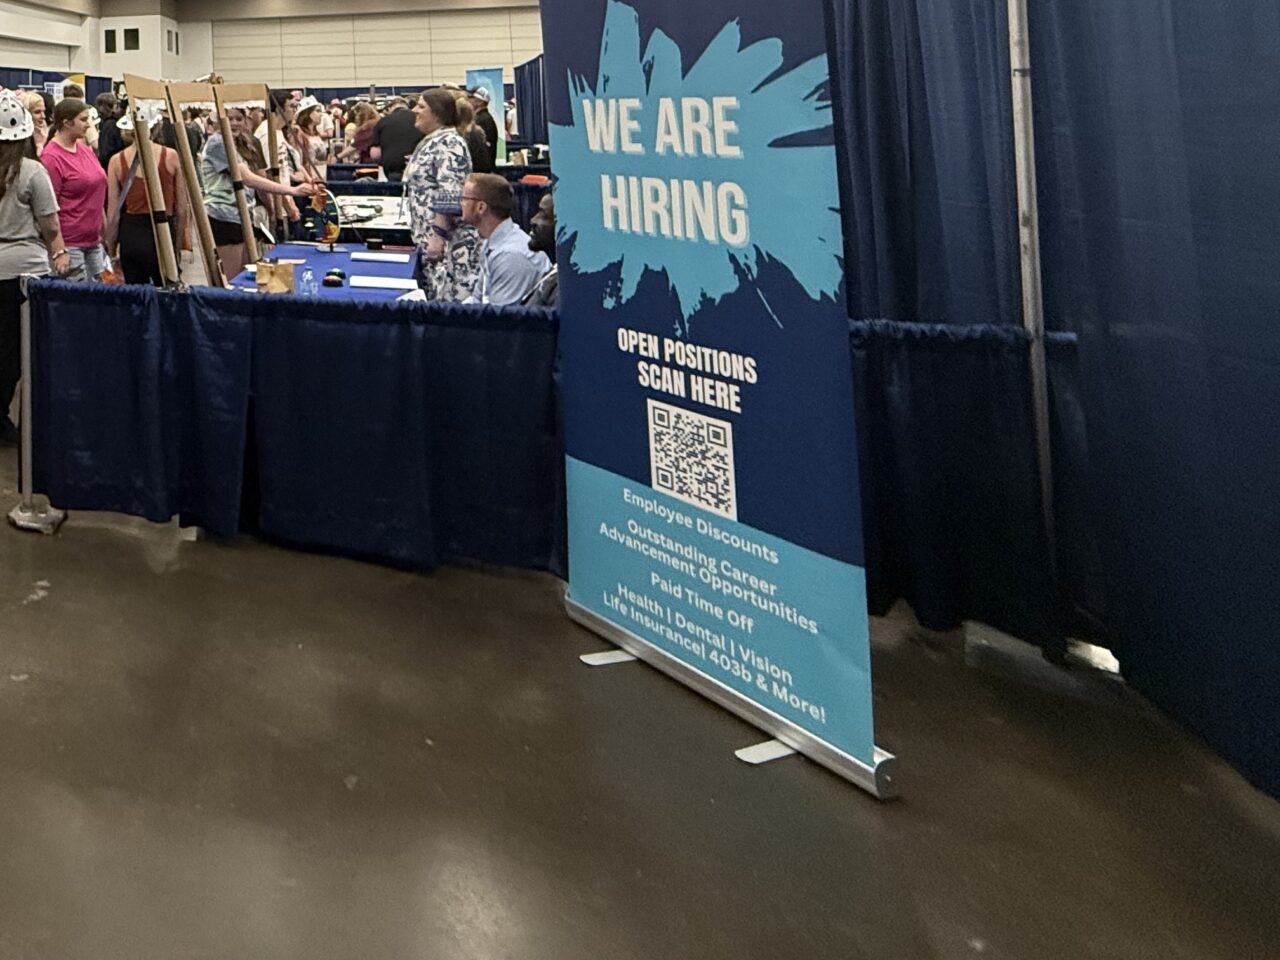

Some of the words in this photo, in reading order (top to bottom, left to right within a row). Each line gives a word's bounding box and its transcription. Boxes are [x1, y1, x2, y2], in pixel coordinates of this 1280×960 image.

[582, 97, 645, 155] WE
[655, 96, 744, 159] ARE
[600, 174, 750, 248] HIRING
[617, 327, 660, 359] OPEN
[663, 337, 758, 384] POSITIONS
[637, 360, 686, 398] SCAN
[690, 374, 742, 414] HERE
[623, 488, 693, 528] Employee
[696, 517, 780, 564] Discounts
[627, 519, 718, 574] Outstanding
[720, 560, 778, 596] Career
[599, 522, 697, 577] Advancement
[699, 567, 819, 634] Opportunities
[651, 572, 682, 599] Paid
[685, 588, 724, 620] Time
[727, 609, 754, 634] Off
[603, 591, 628, 616] Life
[709, 651, 752, 683] 403b
[755, 674, 769, 693] &
[772, 681, 827, 724] More!
[617, 583, 664, 619] Health
[675, 613, 726, 653] Dental
[739, 644, 793, 686] Vision
